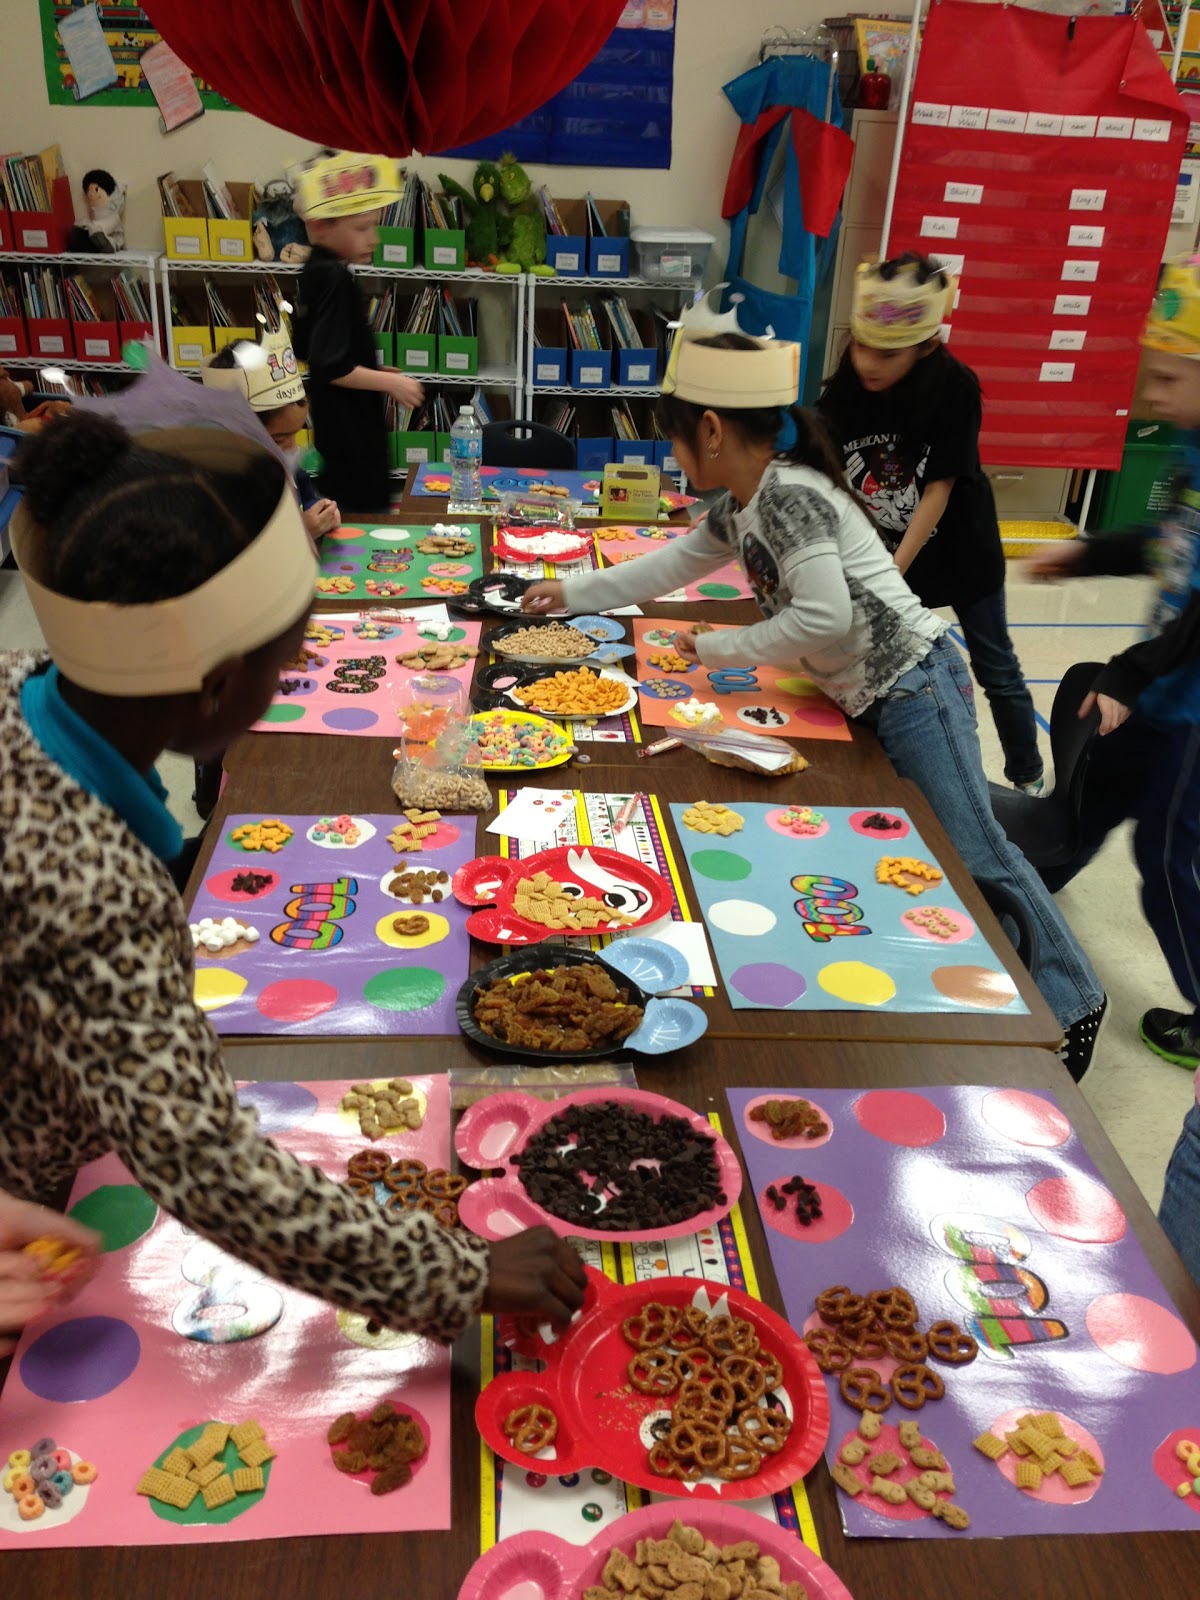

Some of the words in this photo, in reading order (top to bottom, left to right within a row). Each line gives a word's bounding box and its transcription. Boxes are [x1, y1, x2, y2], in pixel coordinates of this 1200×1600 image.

[936, 110, 948, 119] 22
[275, 387, 296, 400] days
[325, 655, 387, 694] 100
[269, 877, 359, 950] 100
[789, 874, 873, 943] 100
[929, 1211, 1070, 1361] 100
